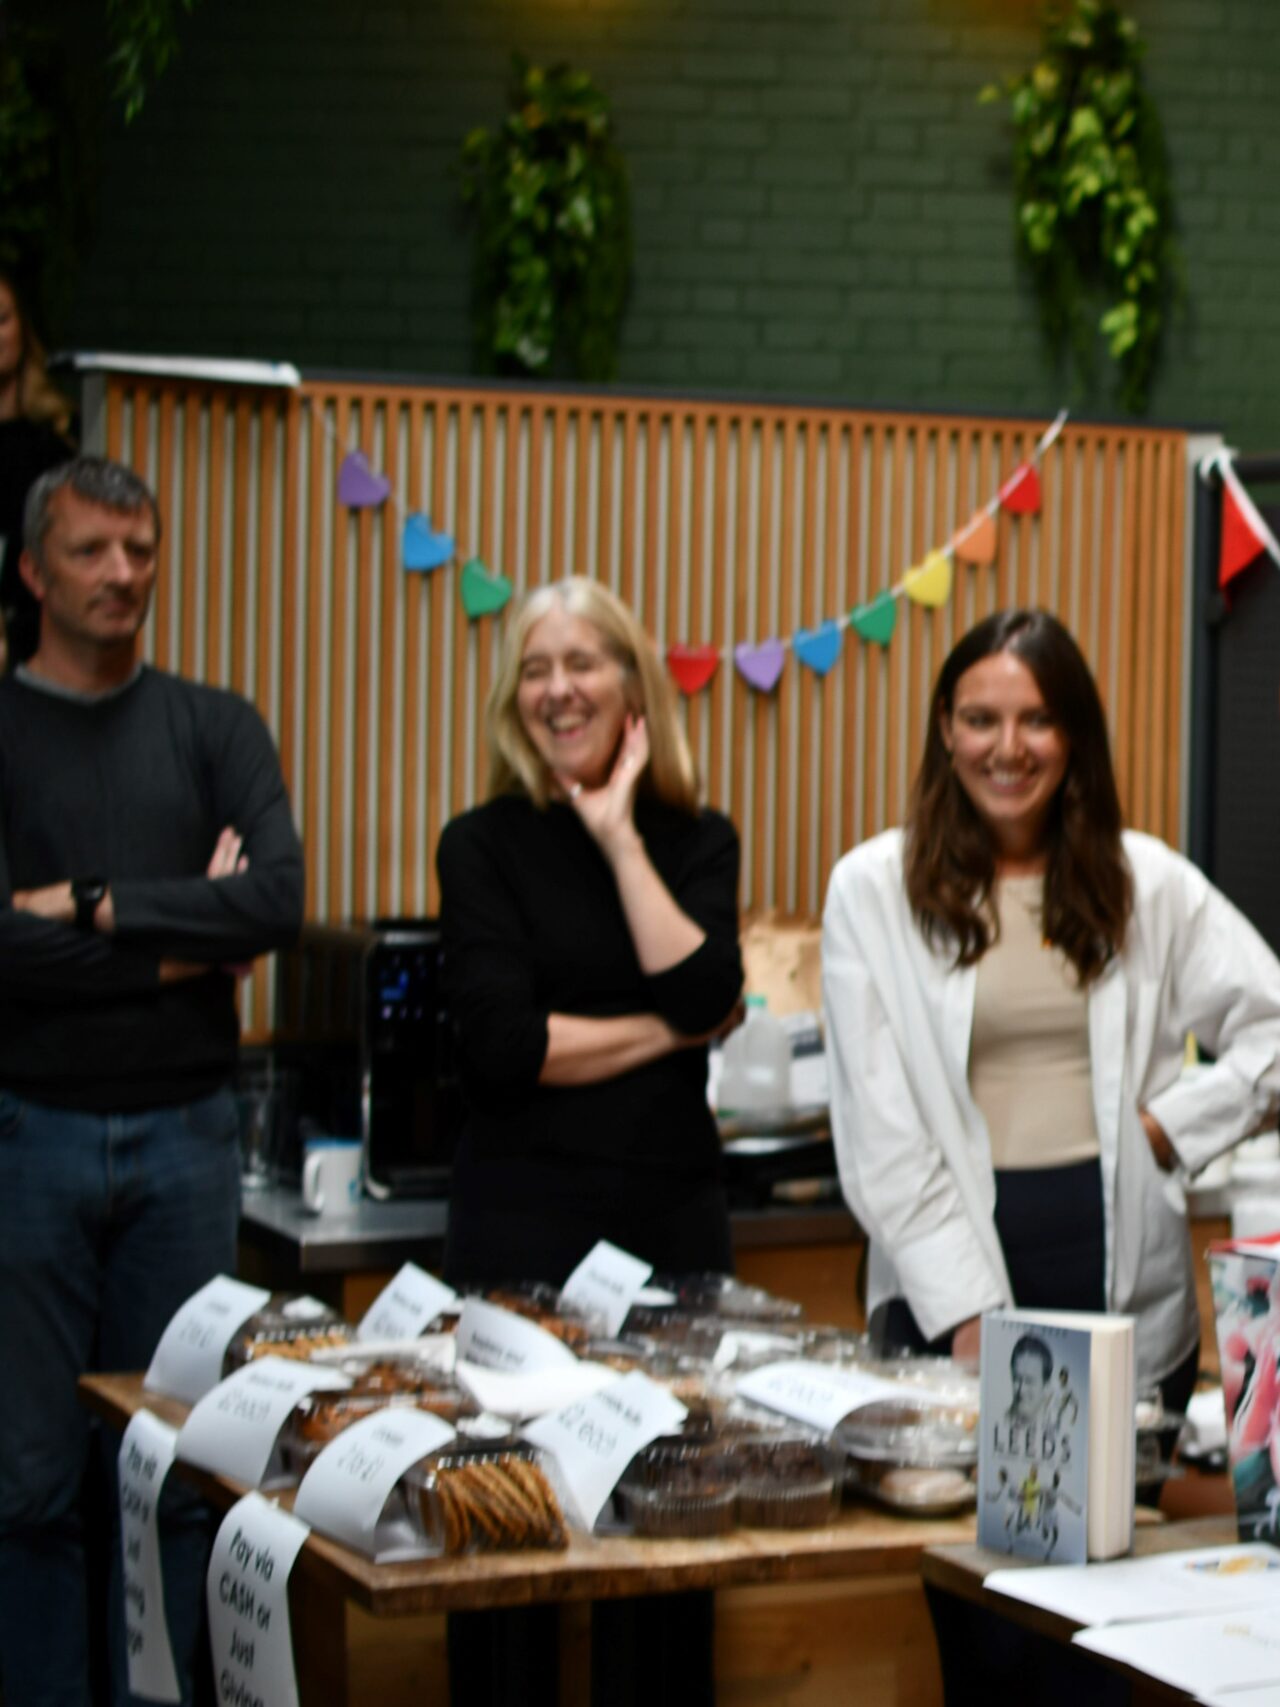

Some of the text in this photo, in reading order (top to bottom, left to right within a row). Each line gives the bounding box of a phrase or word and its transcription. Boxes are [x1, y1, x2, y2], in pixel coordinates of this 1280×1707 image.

[993, 1420, 1072, 1465] LEEDS
[230, 1526, 276, 1583] Pay via
[218, 1573, 256, 1621] CASH
